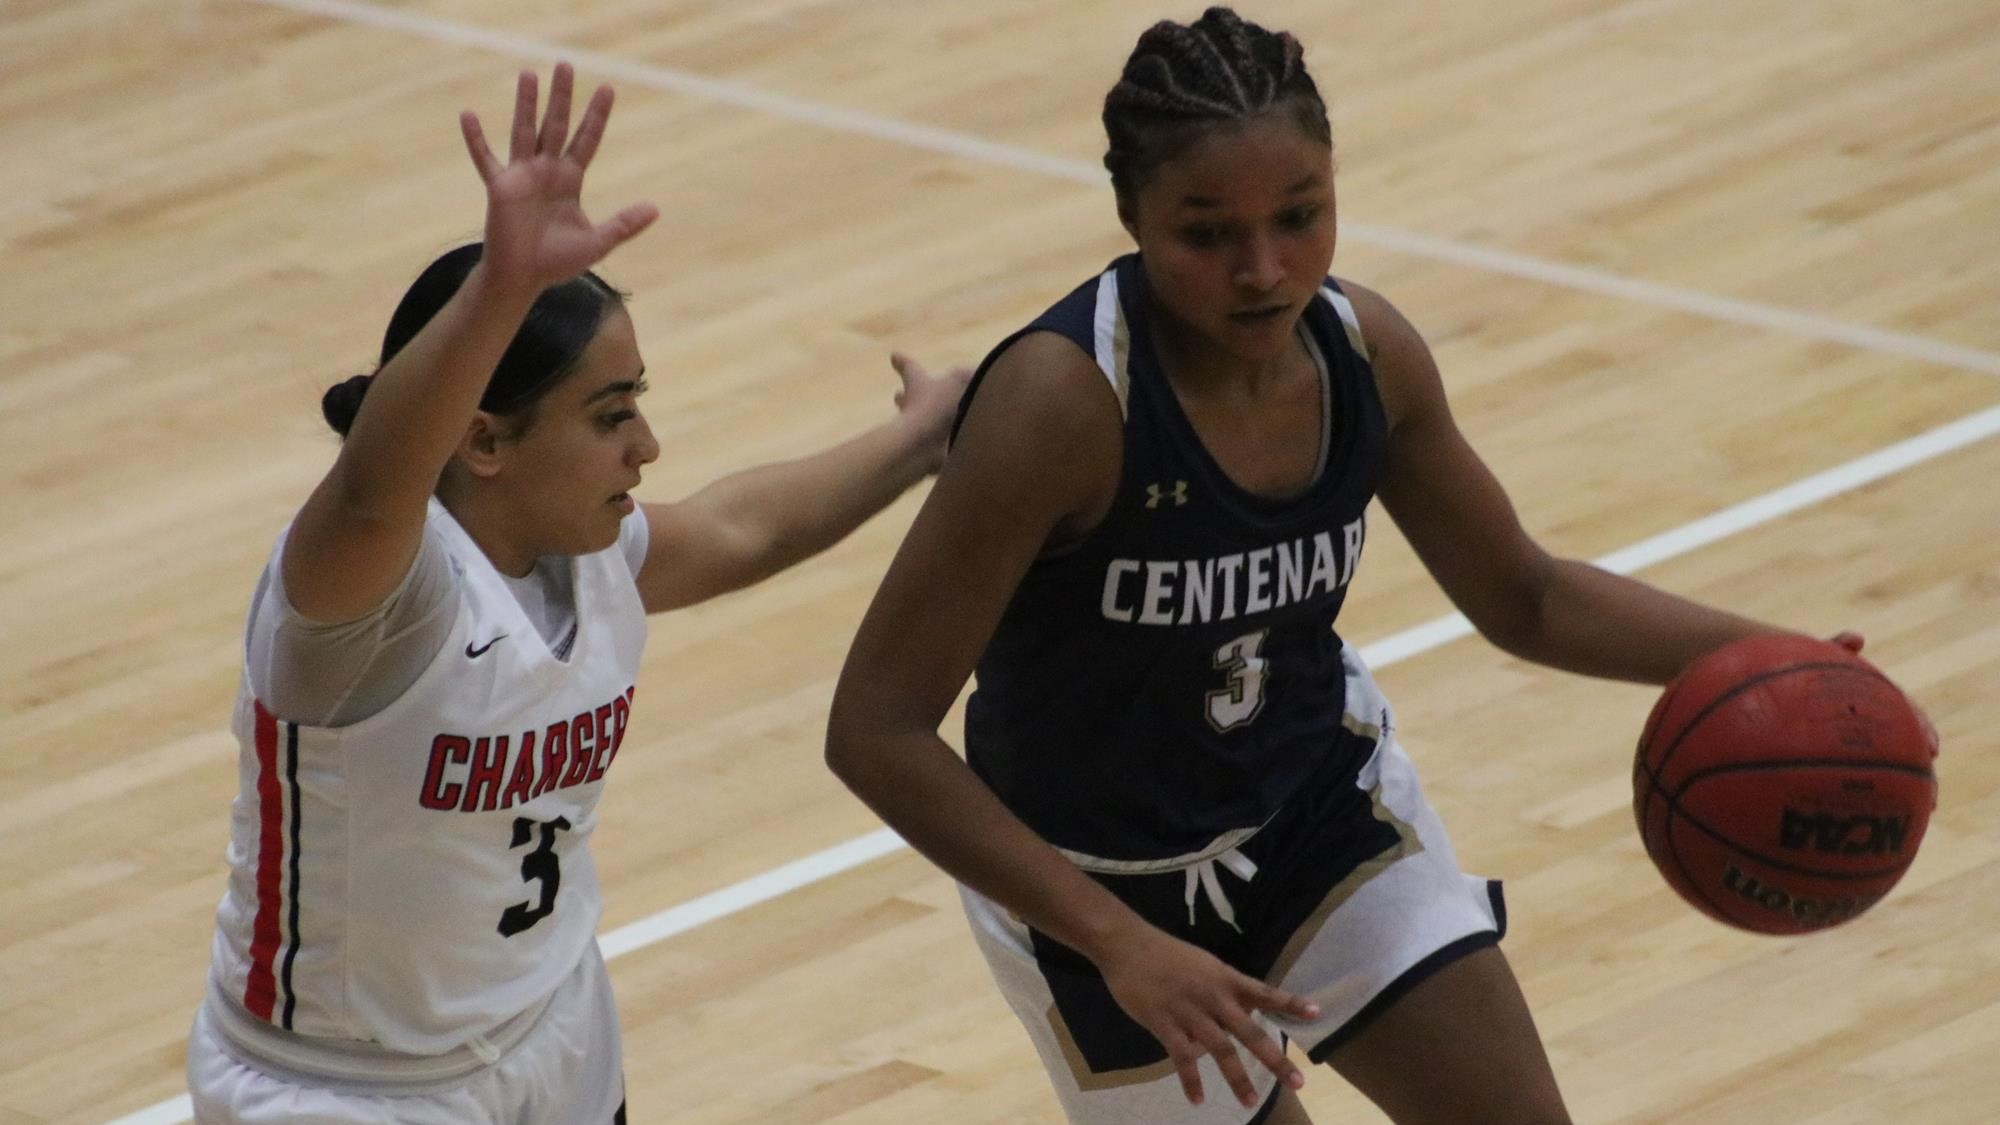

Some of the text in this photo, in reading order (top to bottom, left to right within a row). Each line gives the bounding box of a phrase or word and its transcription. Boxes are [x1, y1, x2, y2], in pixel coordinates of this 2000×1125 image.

[1101, 517, 1362, 625] CENTENAR
[1204, 628, 1270, 734] 3
[419, 686, 635, 812] CHARGER
[496, 815, 572, 938] 3
[1779, 808, 1911, 855] NCAA
